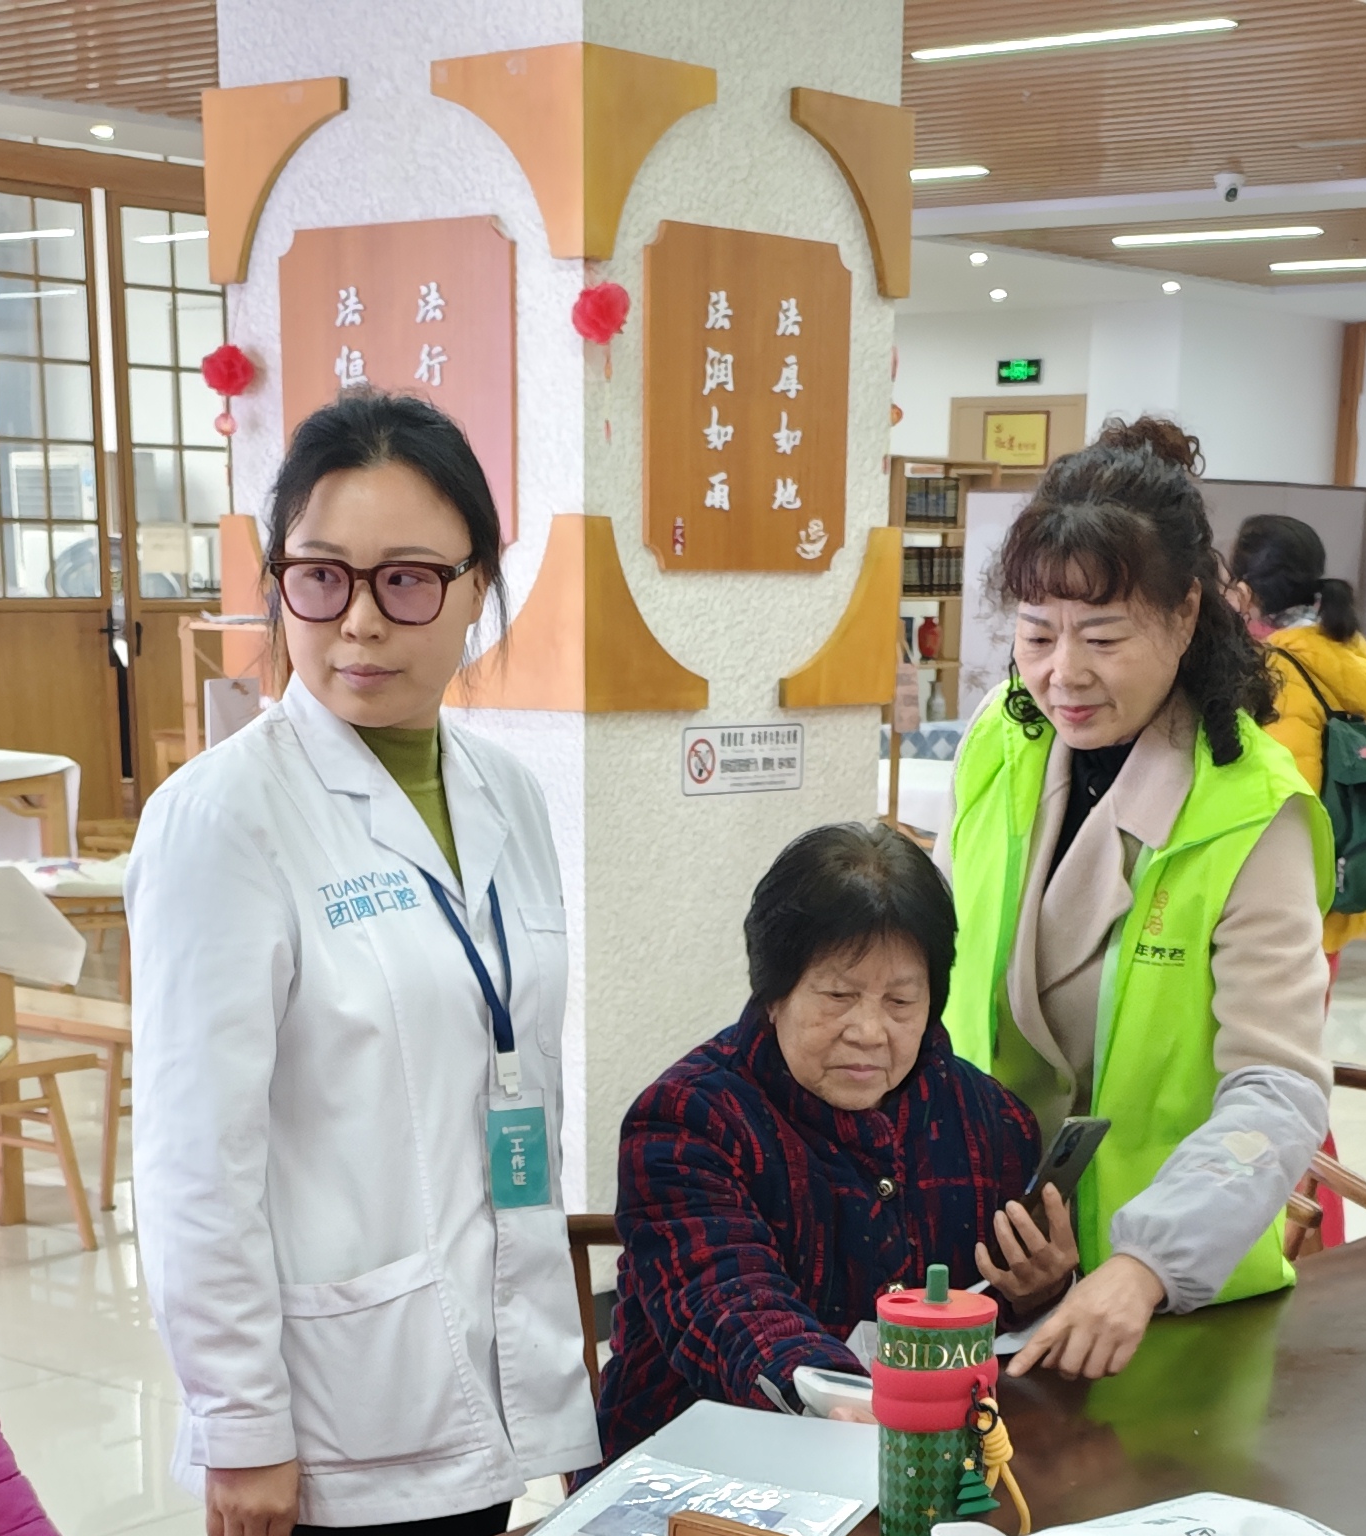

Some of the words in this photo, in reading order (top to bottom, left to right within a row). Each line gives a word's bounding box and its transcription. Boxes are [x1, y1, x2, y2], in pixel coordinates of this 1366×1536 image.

[414, 282, 448, 387] 法行
[702, 291, 735, 511] 法润如雨
[772, 298, 804, 511] 法厚如地
[318, 869, 409, 902] TUANYUAN
[324, 886, 421, 929] 团圆口腔
[510, 1137, 527, 1187] 工作证
